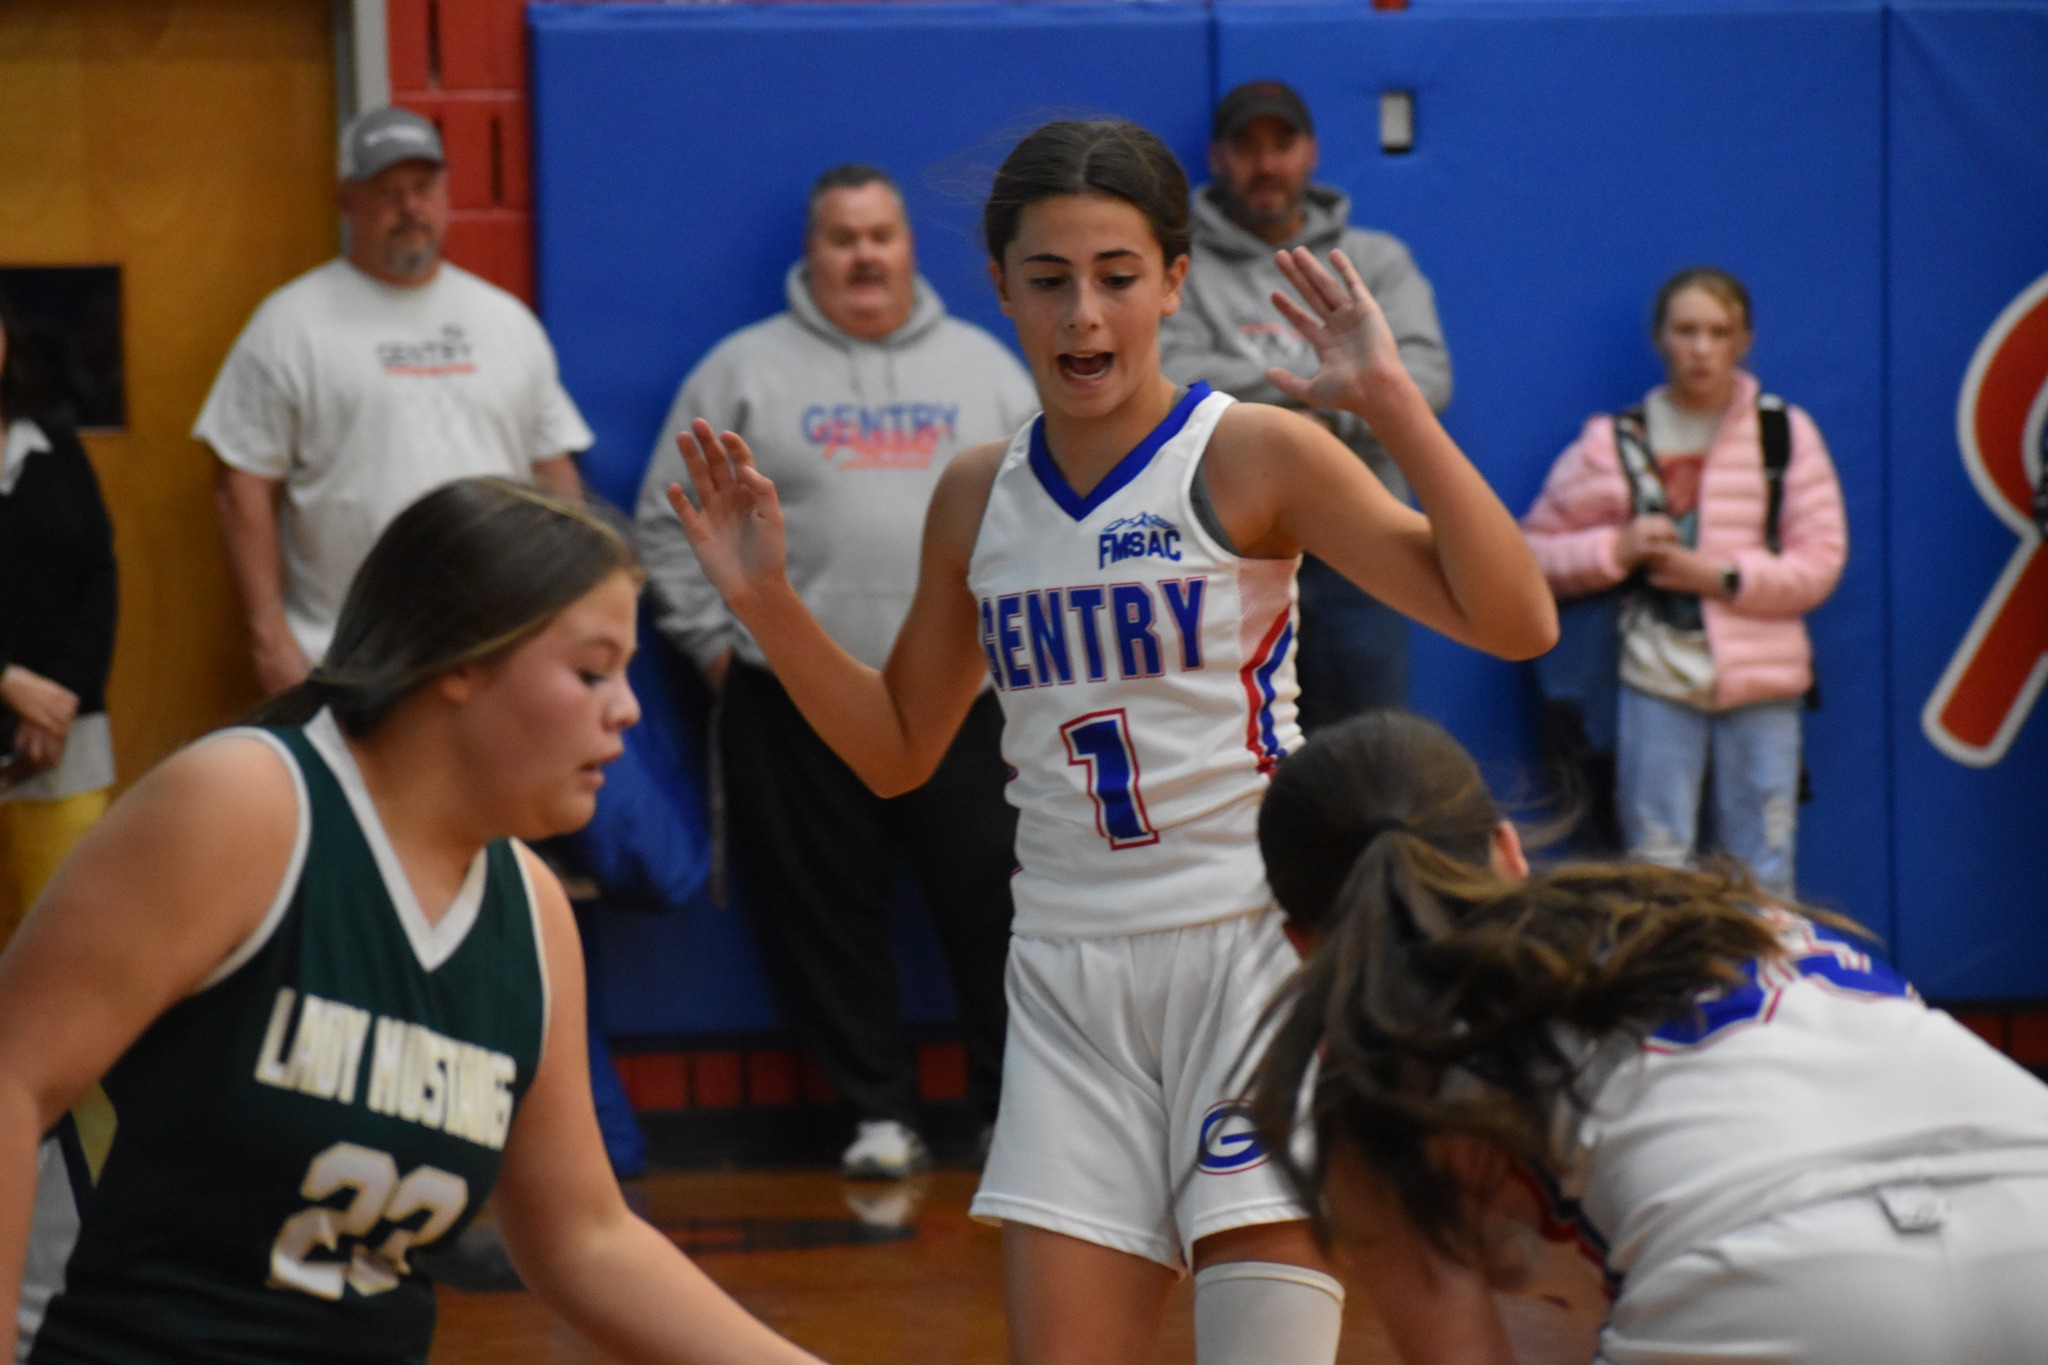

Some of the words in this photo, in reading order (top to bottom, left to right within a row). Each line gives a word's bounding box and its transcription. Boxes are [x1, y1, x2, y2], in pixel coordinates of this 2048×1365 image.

[1099, 530, 1182, 569] FMSAC
[1059, 708, 1160, 851] 1
[255, 987, 371, 1105] LADY
